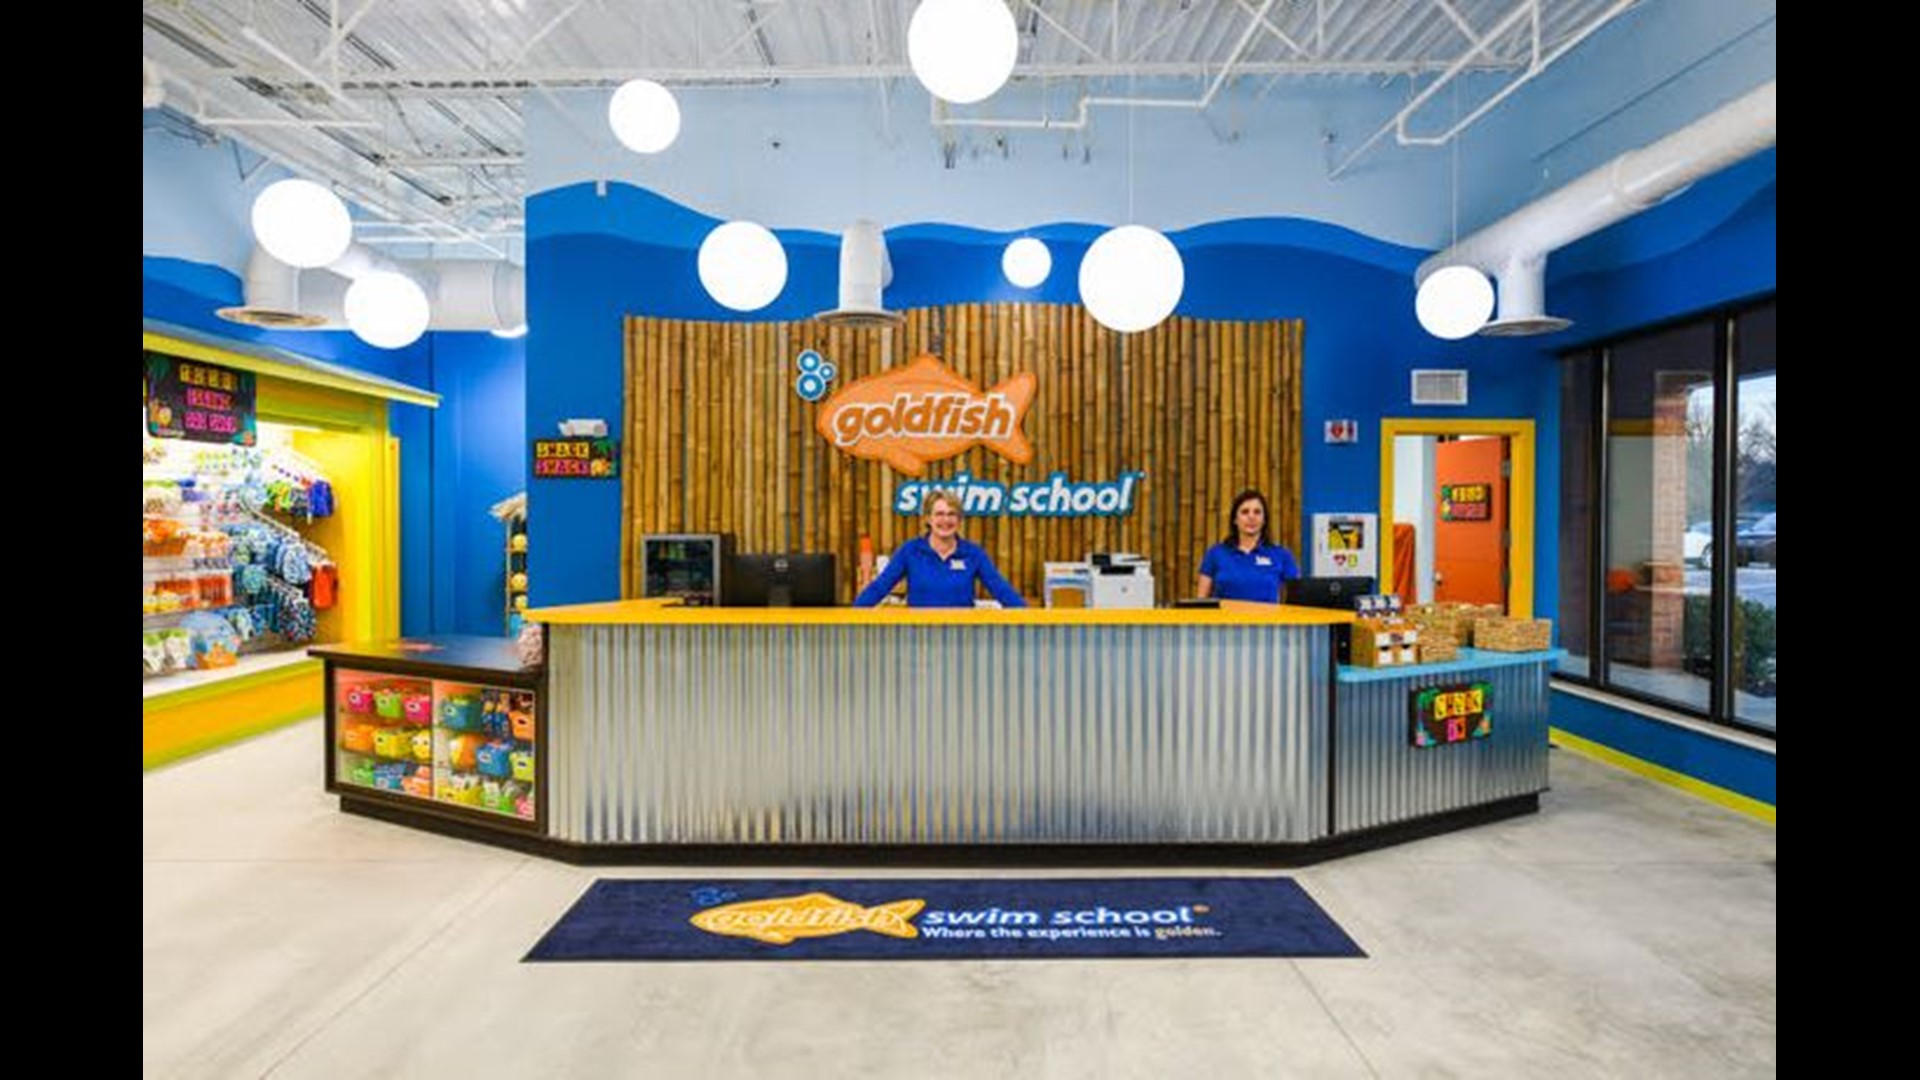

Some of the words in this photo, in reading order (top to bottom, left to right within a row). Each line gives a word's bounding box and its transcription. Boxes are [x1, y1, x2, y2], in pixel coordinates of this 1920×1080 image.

[832, 393, 1014, 446] goldfish
[536, 441, 589, 458] SNACK
[1009, 476, 1134, 512] school
[923, 907, 1039, 924] swim
[1053, 906, 1193, 924] school
[922, 926, 986, 938] Where
[991, 926, 1023, 938] the
[1027, 926, 1131, 941] experience
[1134, 926, 1150, 938] is
